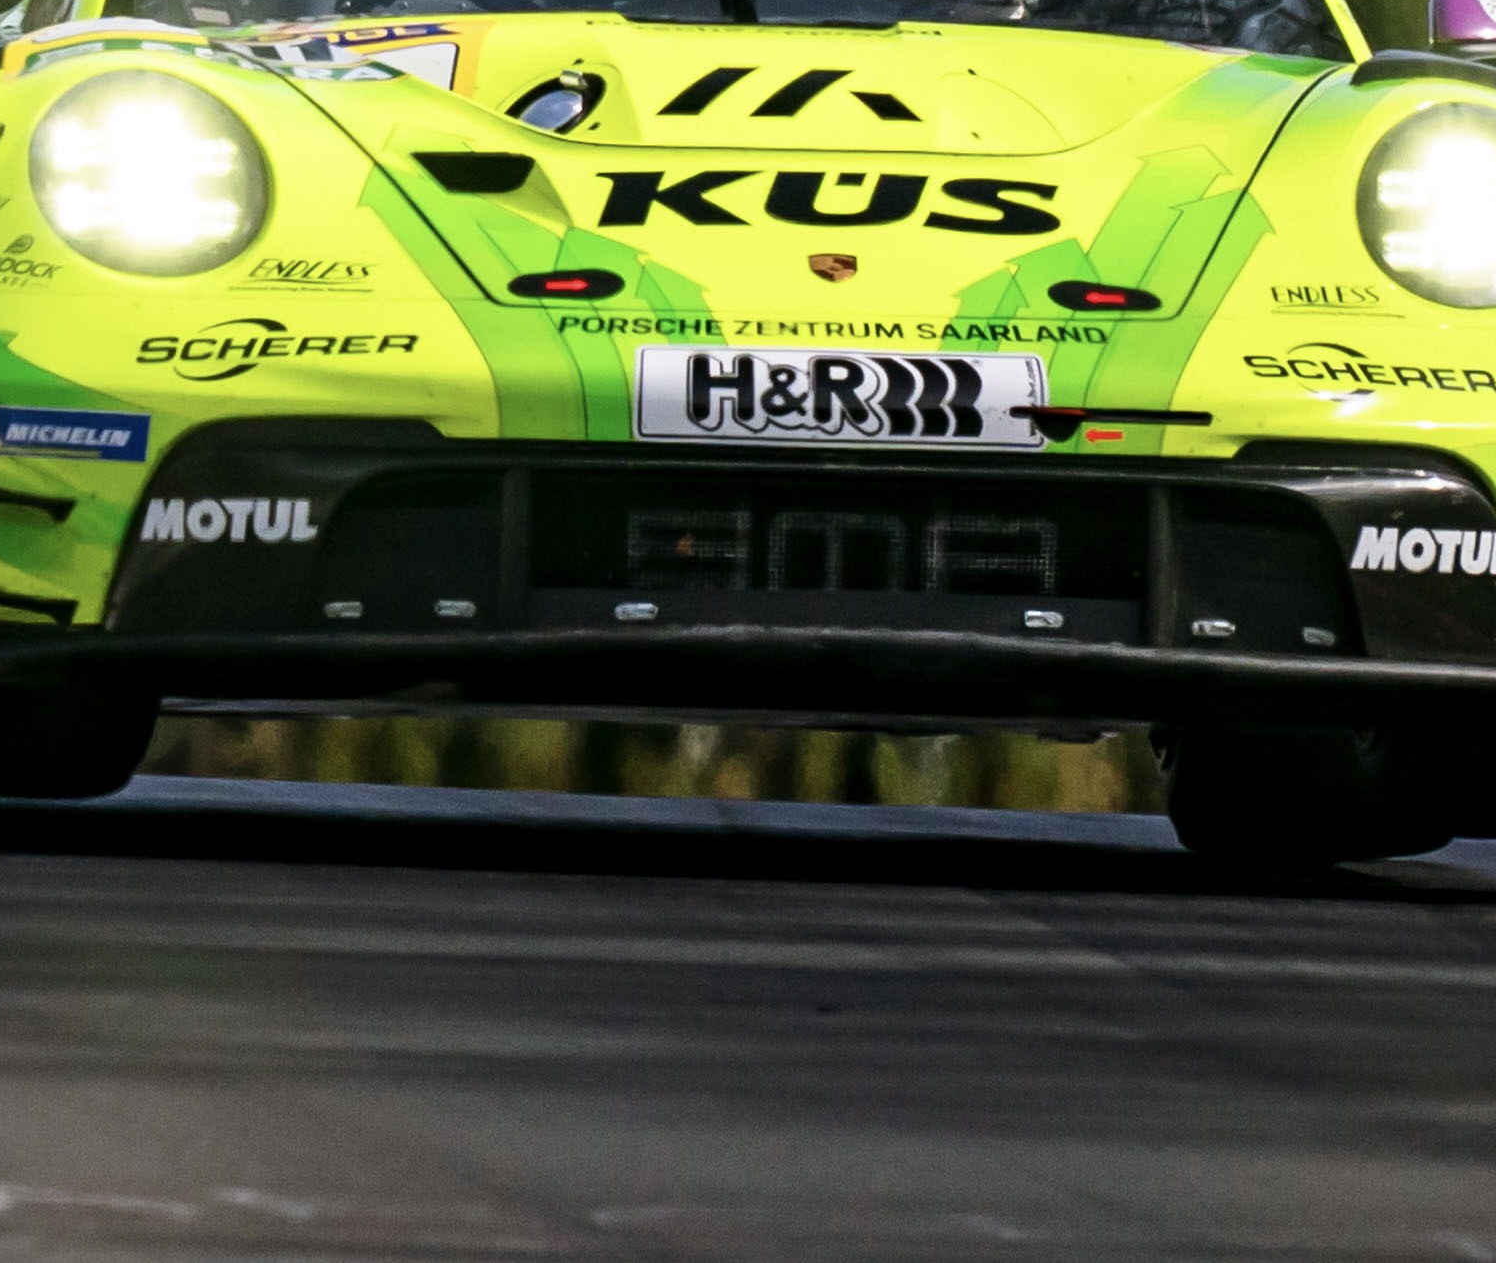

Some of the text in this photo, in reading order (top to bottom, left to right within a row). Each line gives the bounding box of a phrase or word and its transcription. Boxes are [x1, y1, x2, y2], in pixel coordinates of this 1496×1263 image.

[596, 170, 1061, 235] KÜS
[249, 258, 379, 280] ENDLESS
[1271, 285, 1381, 304] ENDLESS
[558, 317, 1108, 345] PORSCHE ZENTRUM SAARLAND
[136, 334, 418, 365] SCHERER
[687, 353, 885, 437] H&R
[5, 423, 132, 448] MICHELIN
[140, 498, 318, 543] MOTUL
